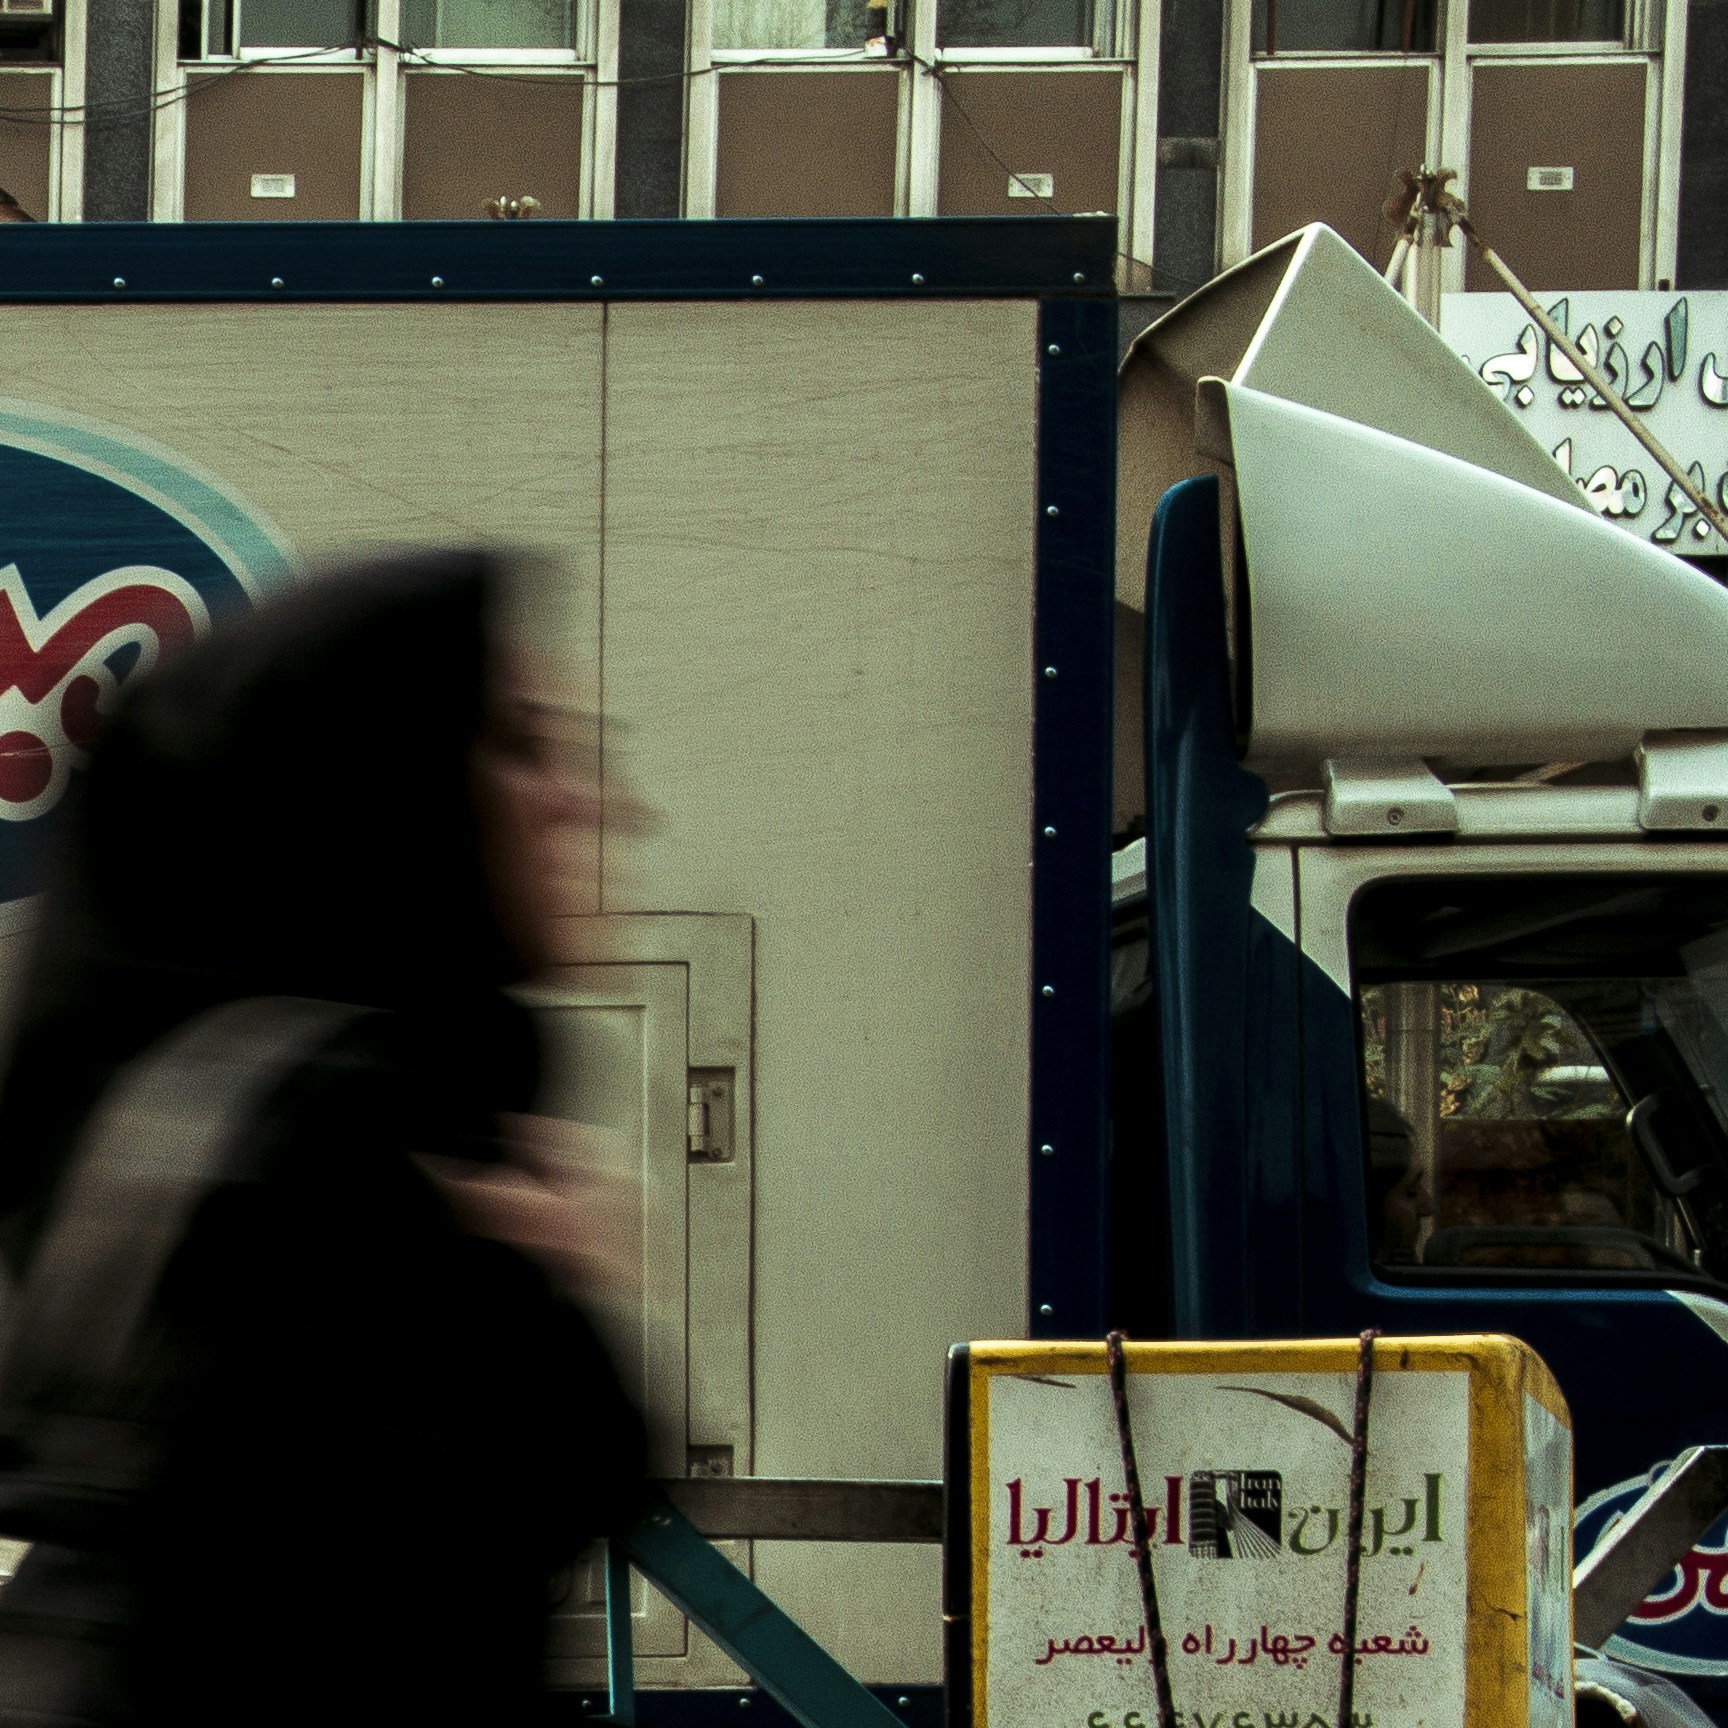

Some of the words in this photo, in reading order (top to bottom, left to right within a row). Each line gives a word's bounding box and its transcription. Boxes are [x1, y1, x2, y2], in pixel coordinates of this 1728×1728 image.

[1240, 1472, 1281, 1490] Iran
[1240, 1490, 1281, 1511] Italy
[1005, 1476, 1184, 1558] ایتالیا
[1287, 1473, 1443, 1557] ایرن
[1035, 1626, 1167, 1665] لیعصر
[1328, 1625, 1430, 1664] شعبه
